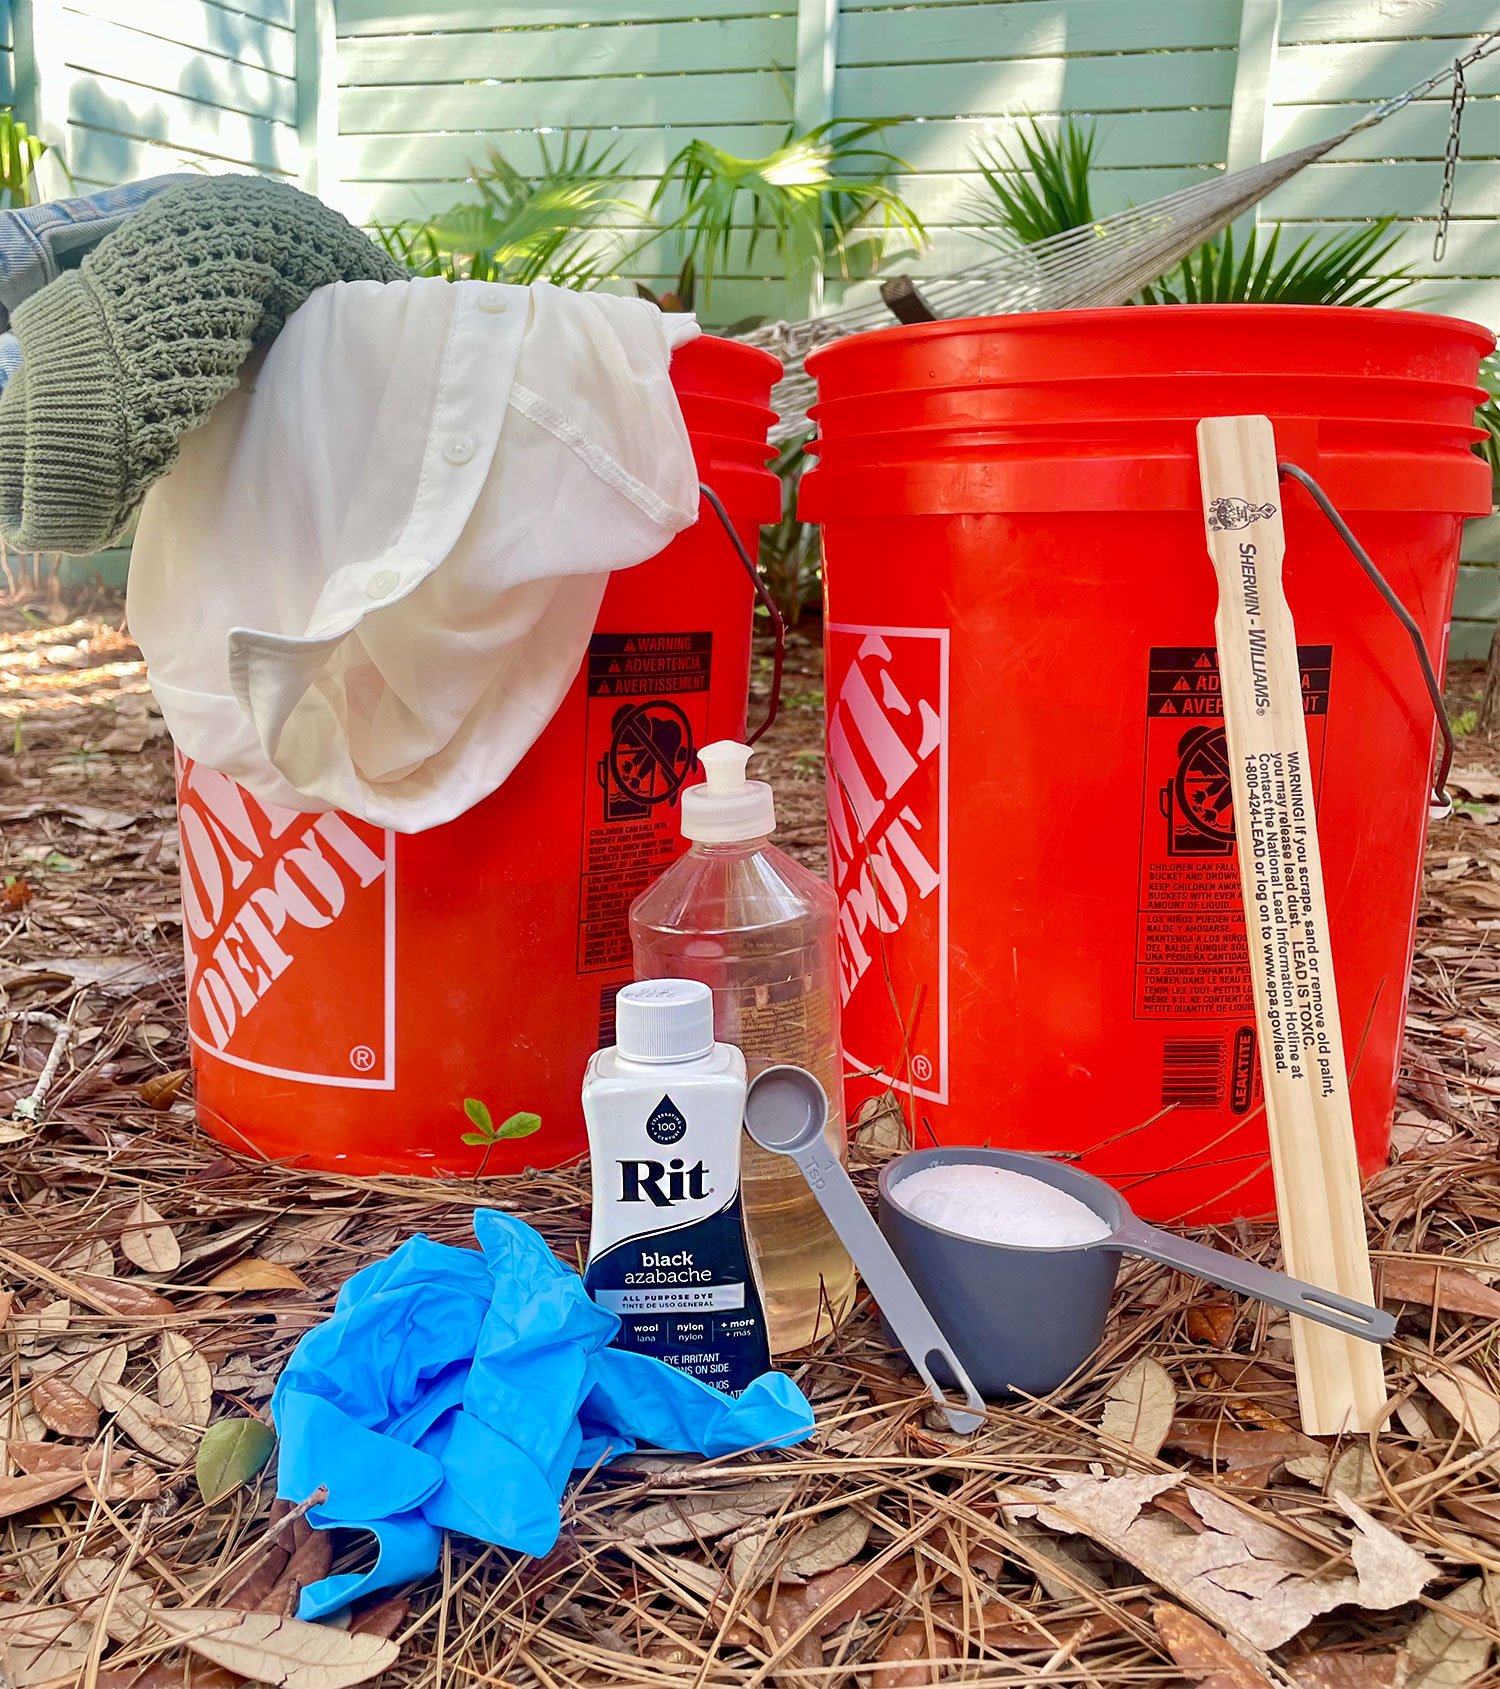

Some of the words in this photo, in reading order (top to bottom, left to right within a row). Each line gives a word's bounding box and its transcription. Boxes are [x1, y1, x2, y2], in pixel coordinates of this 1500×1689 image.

[1239, 543, 1260, 616] SHERWIN
[638, 637, 691, 651] WARNING
[625, 656, 700, 672] ADVERTENCIA
[614, 675, 705, 693] AVERTISSEMENT
[1270, 752, 1283, 777] you
[1259, 753, 1273, 804] Contact
[1274, 781, 1287, 808] may
[1245, 754, 1265, 858] 1-800-424-LEAD
[1263, 807, 1276, 828] the
[1278, 812, 1292, 859] release
[1295, 826, 1306, 835] If
[1293, 838, 1307, 862] you
[1266, 832, 1283, 886] National
[1149, 863, 1193, 871] CHILDREN
[1196, 863, 1213, 871] CAN
[1216, 863, 1235, 871] FALL
[1255, 862, 1265, 876] or
[1149, 872, 1182, 880] BUCKET
[1186, 872, 1203, 880] AND
[1284, 863, 1298, 891] lead
[1149, 883, 1170, 891] KEEP
[1173, 883, 1215, 891] CHILDREN
[1218, 882, 1241, 890] AWAY
[1255, 880, 1268, 901] log
[1299, 866, 1312, 916] scrape,
[1149, 892, 1187, 900] BUCKETS
[1189, 892, 1212, 900] WITH
[1215, 892, 1236, 900] EVEN
[838, 805, 941, 1009] EPOT
[1148, 901, 1185, 909] AMOUNT
[1188, 901, 1199, 909] OF
[1272, 891, 1287, 924] Lead
[1287, 895, 1302, 929] dust.
[1147, 915, 1164, 923] LOS
[1196, 915, 1229, 923] PUEDEN
[1259, 905, 1270, 922] on
[196, 809, 387, 1052] DEPOT
[1261, 925, 1273, 940] to
[1304, 920, 1319, 954] sand
[1147, 935, 1193, 943] MANTENGA
[1204, 934, 1221, 942] LOS
[1146, 944, 1161, 952] DEL
[1165, 944, 1191, 952] BALDE
[1194, 943, 1228, 952] AUNQUE
[1231, 943, 1249, 951] SOL
[1146, 953, 1163, 961] UNA
[1207, 952, 1248, 960] CANTIDAD
[1292, 941, 1308, 980] LEAD
[1145, 967, 1160, 975] LES
[1163, 967, 1195, 975] JEUNES
[1198, 967, 1233, 975] ENFANTS
[1276, 928, 1294, 1007] Information
[1309, 958, 1319, 973] or
[1145, 976, 1180, 984] TOMBER
[1183, 976, 1205, 984] DANS
[1208, 976, 1217, 984] LE
[1220, 976, 1241, 984] SEAU
[1144, 986, 1168, 994] TENIR
[1171, 986, 1186, 994] LES
[1189, 985, 1241, 994] TOUT-PETITS
[1297, 984, 1310, 998] IS
[1190, 995, 1200, 1003] NE
[1202, 995, 1242, 1003] CONTIENT
[1311, 977, 1325, 1028] remove
[1143, 1005, 1171, 1013] PETITE
[1216, 1004, 1226, 1012] DE
[1229, 1003, 1255, 1012] LIQUID
[1263, 943, 1288, 1074] www.epa.gov/lead.
[1299, 1001, 1315, 1050] TOXIC.
[1285, 1011, 1300, 1061] Hotline
[1317, 1032, 1331, 1054] old
[1234, 1035, 1251, 1106] LEAKTITE
[1291, 1065, 1304, 1079] at
[1317, 1058, 1335, 1097] paint,
[651, 1112, 682, 1126] CELEBRATING
[657, 1122, 676, 1131] 100
[657, 1130, 680, 1141] CENTURY
[805, 1155, 826, 1190] Tsp
[615, 1157, 710, 1207] Rit
[641, 1250, 693, 1267] black
[624, 1267, 712, 1284] azabache
[644, 1293, 690, 1301] PURPOSE
[694, 1292, 713, 1300] DYE
[633, 1323, 659, 1332] wool
[676, 1323, 704, 1334] nylon
[729, 1318, 755, 1329] more
[637, 1334, 656, 1342] lana
[678, 1333, 704, 1342] nylon
[733, 1329, 751, 1338] más
[681, 1352, 720, 1364] IRRITANT
[695, 1365, 708, 1375] ON
